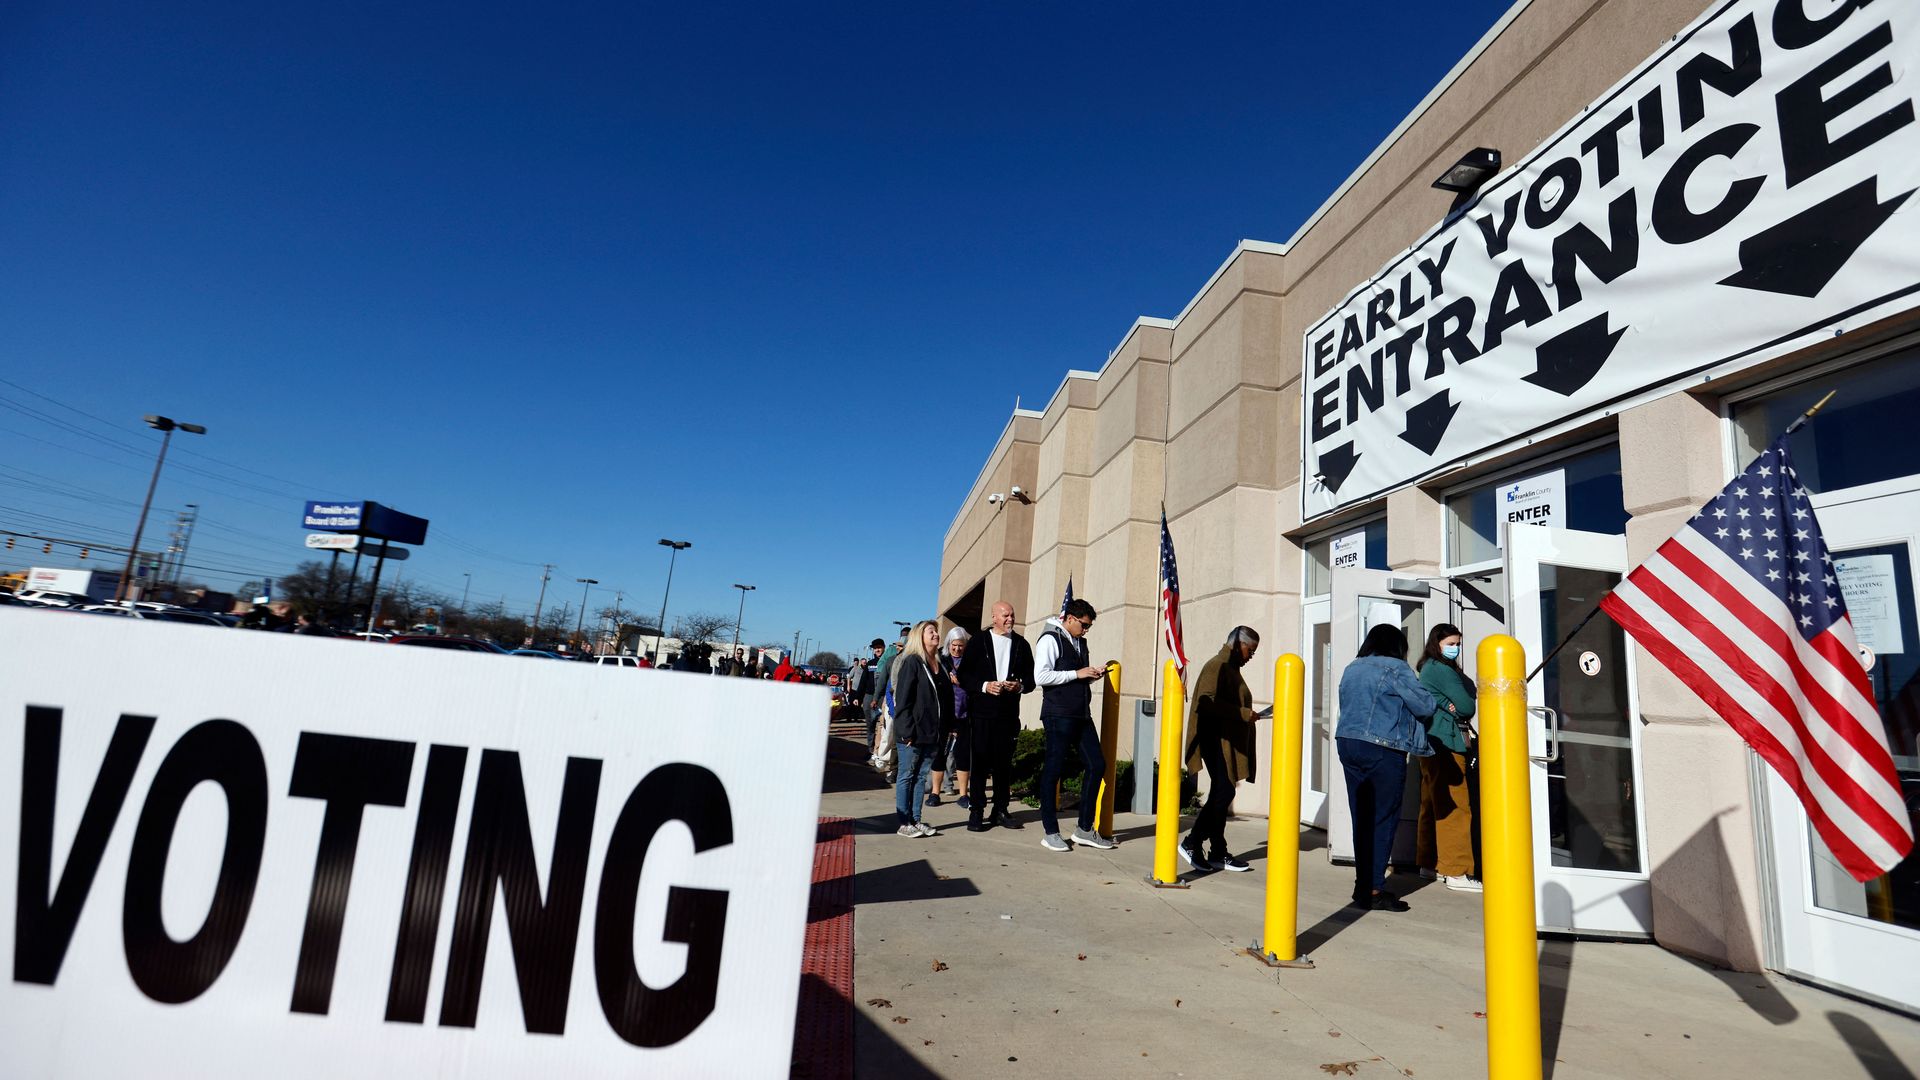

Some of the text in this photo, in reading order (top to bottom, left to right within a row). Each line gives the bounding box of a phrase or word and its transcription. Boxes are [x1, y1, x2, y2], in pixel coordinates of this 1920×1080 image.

[1312, 20, 1915, 444] ENTRANCE
[1314, 237, 1454, 379] EARLY
[1509, 504, 1551, 522] ENTER
[1515, 491, 1535, 499] Franklin
[1336, 553, 1357, 565] ENTER
[13, 704, 734, 1049] VOTING
